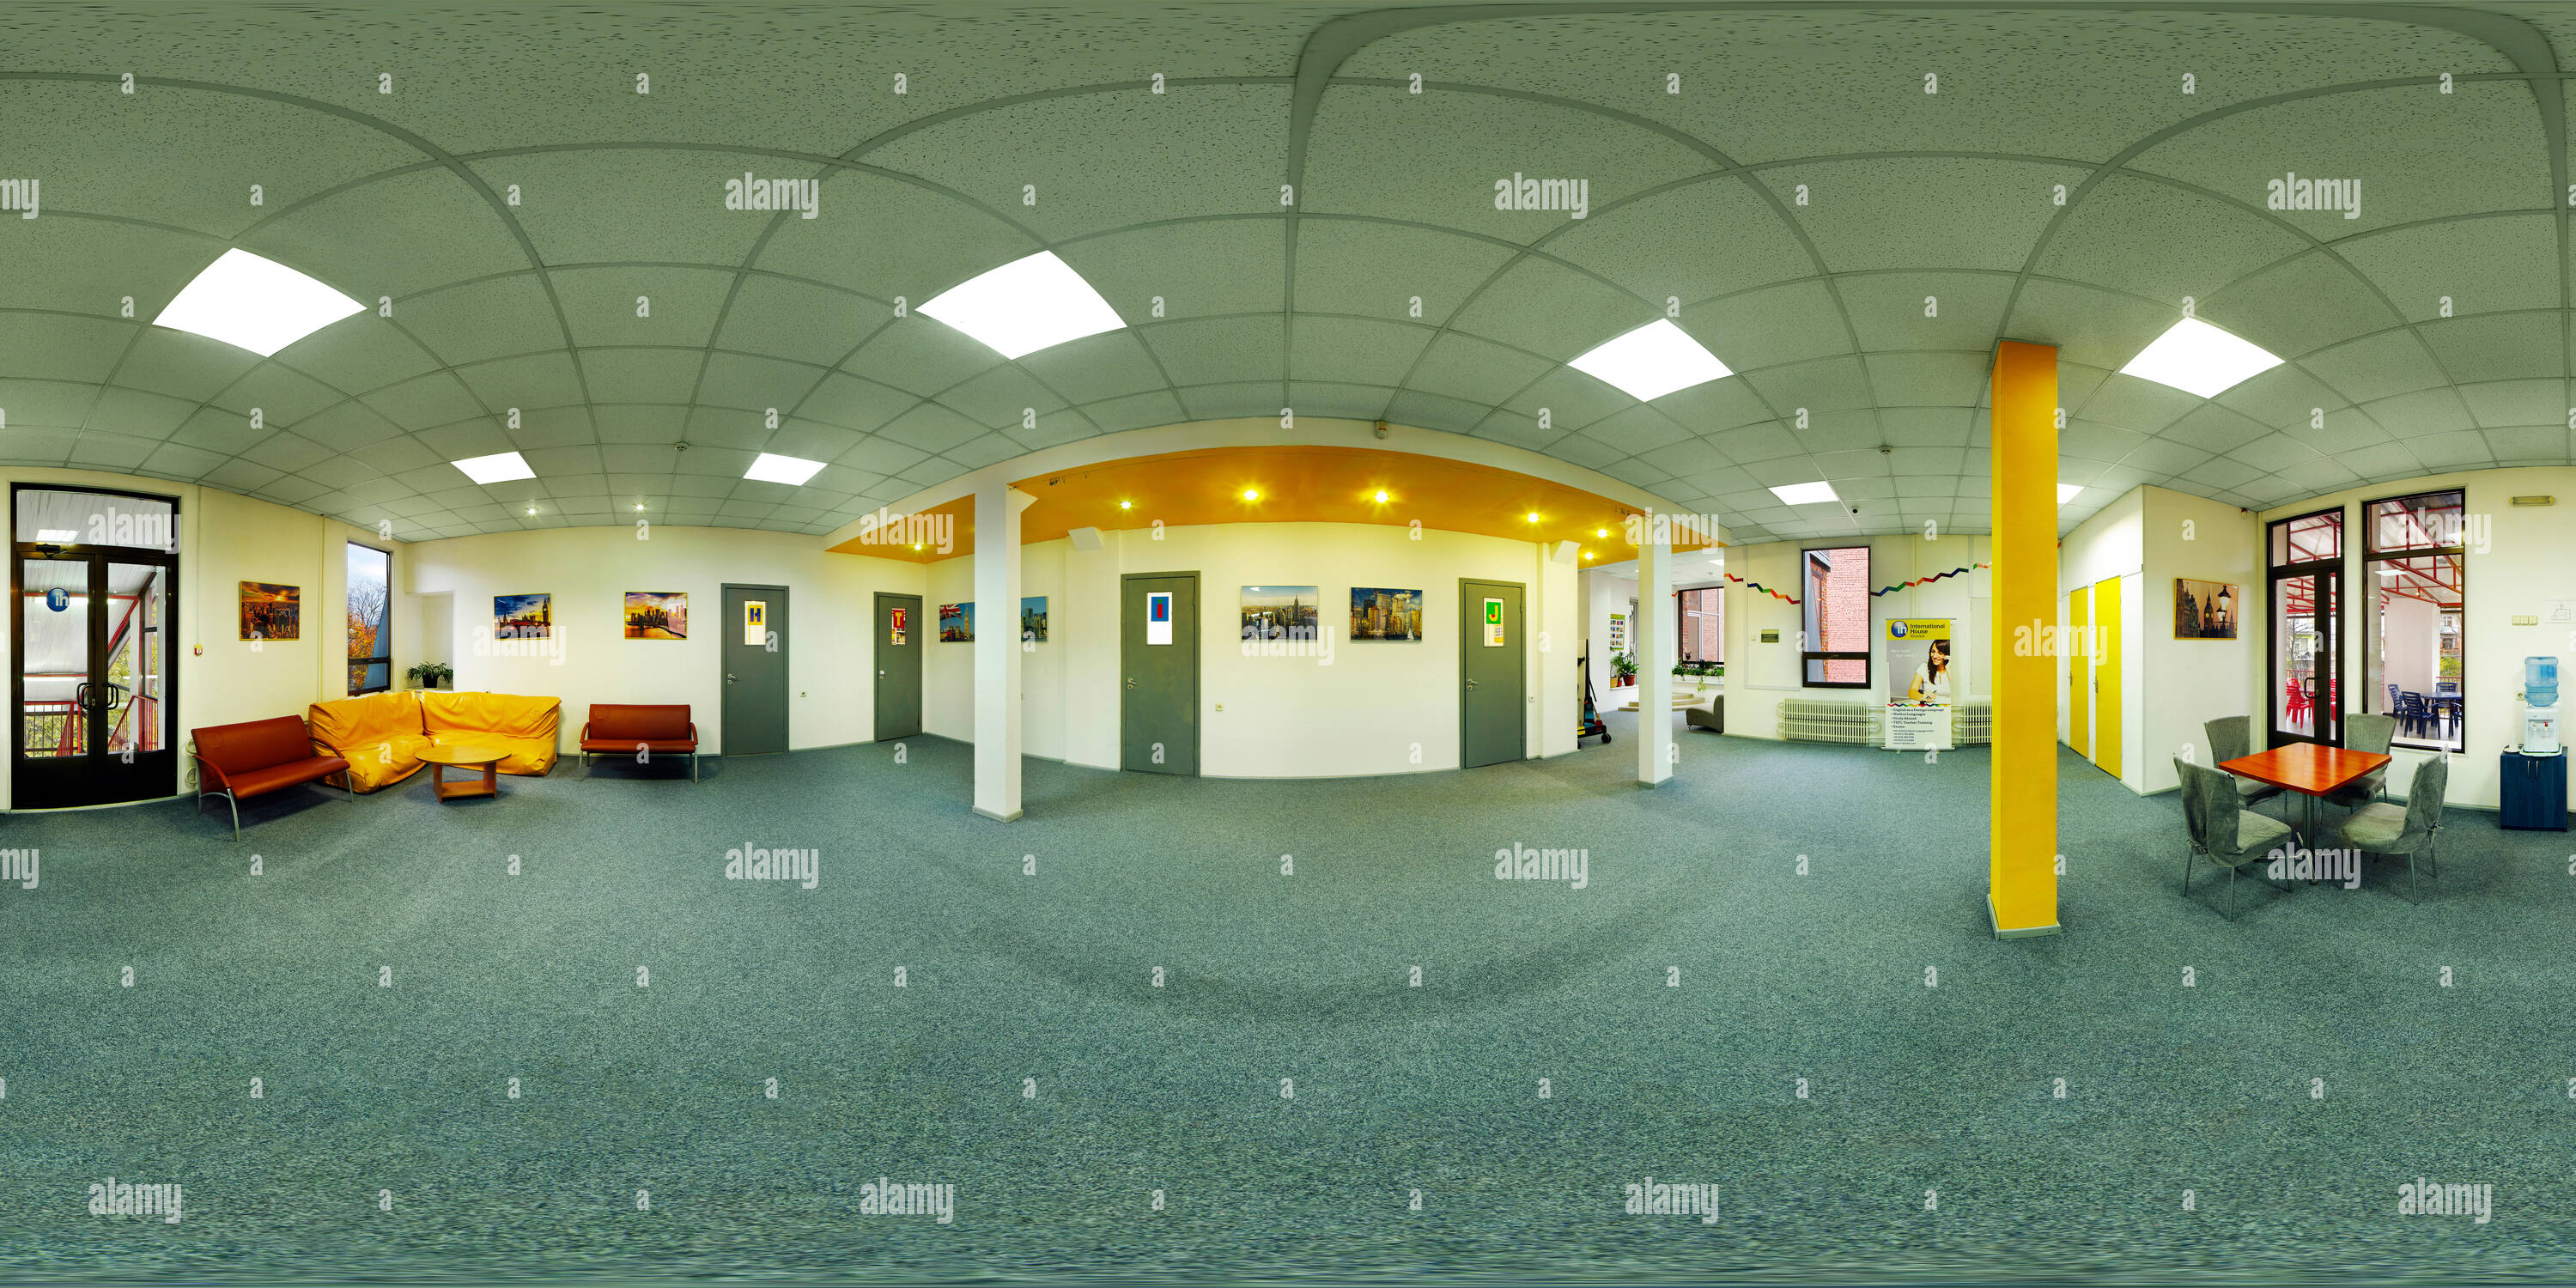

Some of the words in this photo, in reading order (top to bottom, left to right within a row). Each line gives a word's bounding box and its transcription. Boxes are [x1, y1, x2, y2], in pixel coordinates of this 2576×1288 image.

[56, 592, 69, 606] ih
[750, 608, 761, 622] H
[896, 612, 902, 626] T
[1489, 605, 1498, 622] J
